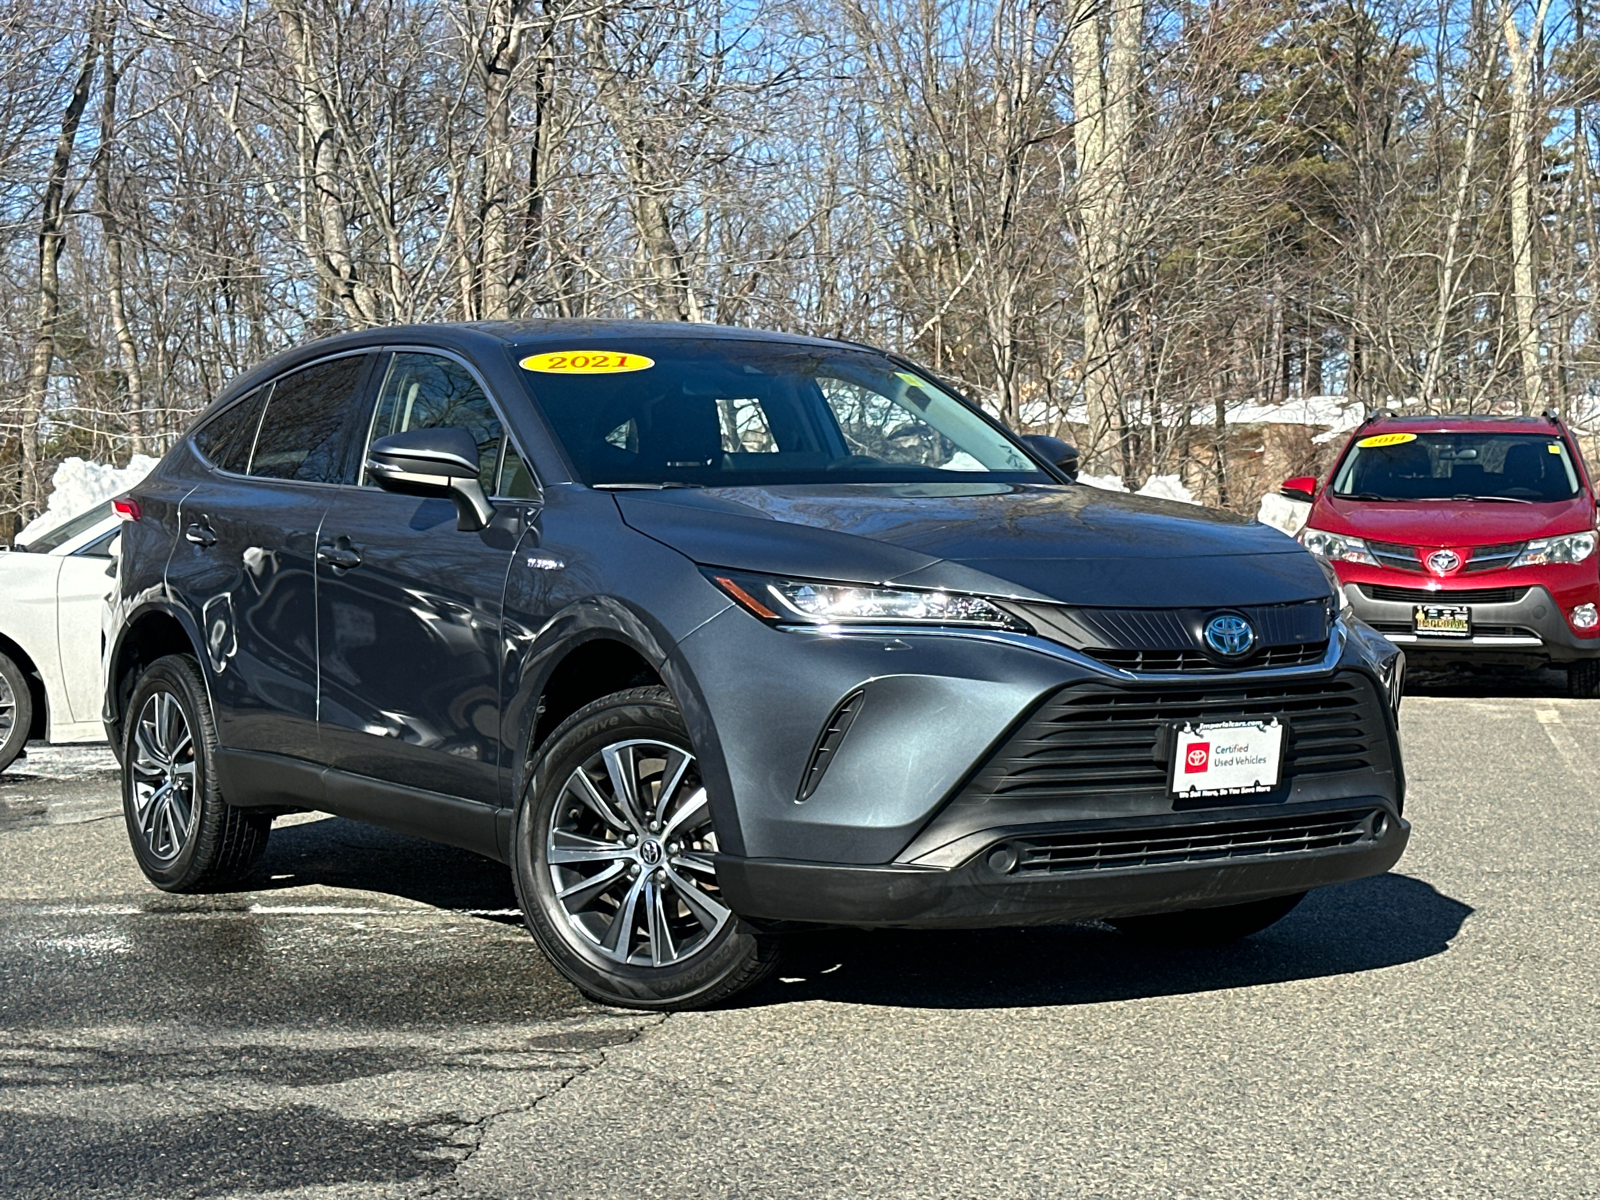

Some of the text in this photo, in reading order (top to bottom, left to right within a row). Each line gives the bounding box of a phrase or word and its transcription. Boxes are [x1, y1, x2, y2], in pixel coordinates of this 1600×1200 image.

[547, 355, 629, 370] 2021
[1368, 435, 1406, 446] 2014
[1215, 743, 1250, 755] Certified
[1214, 754, 1267, 767] Used Vehicles
